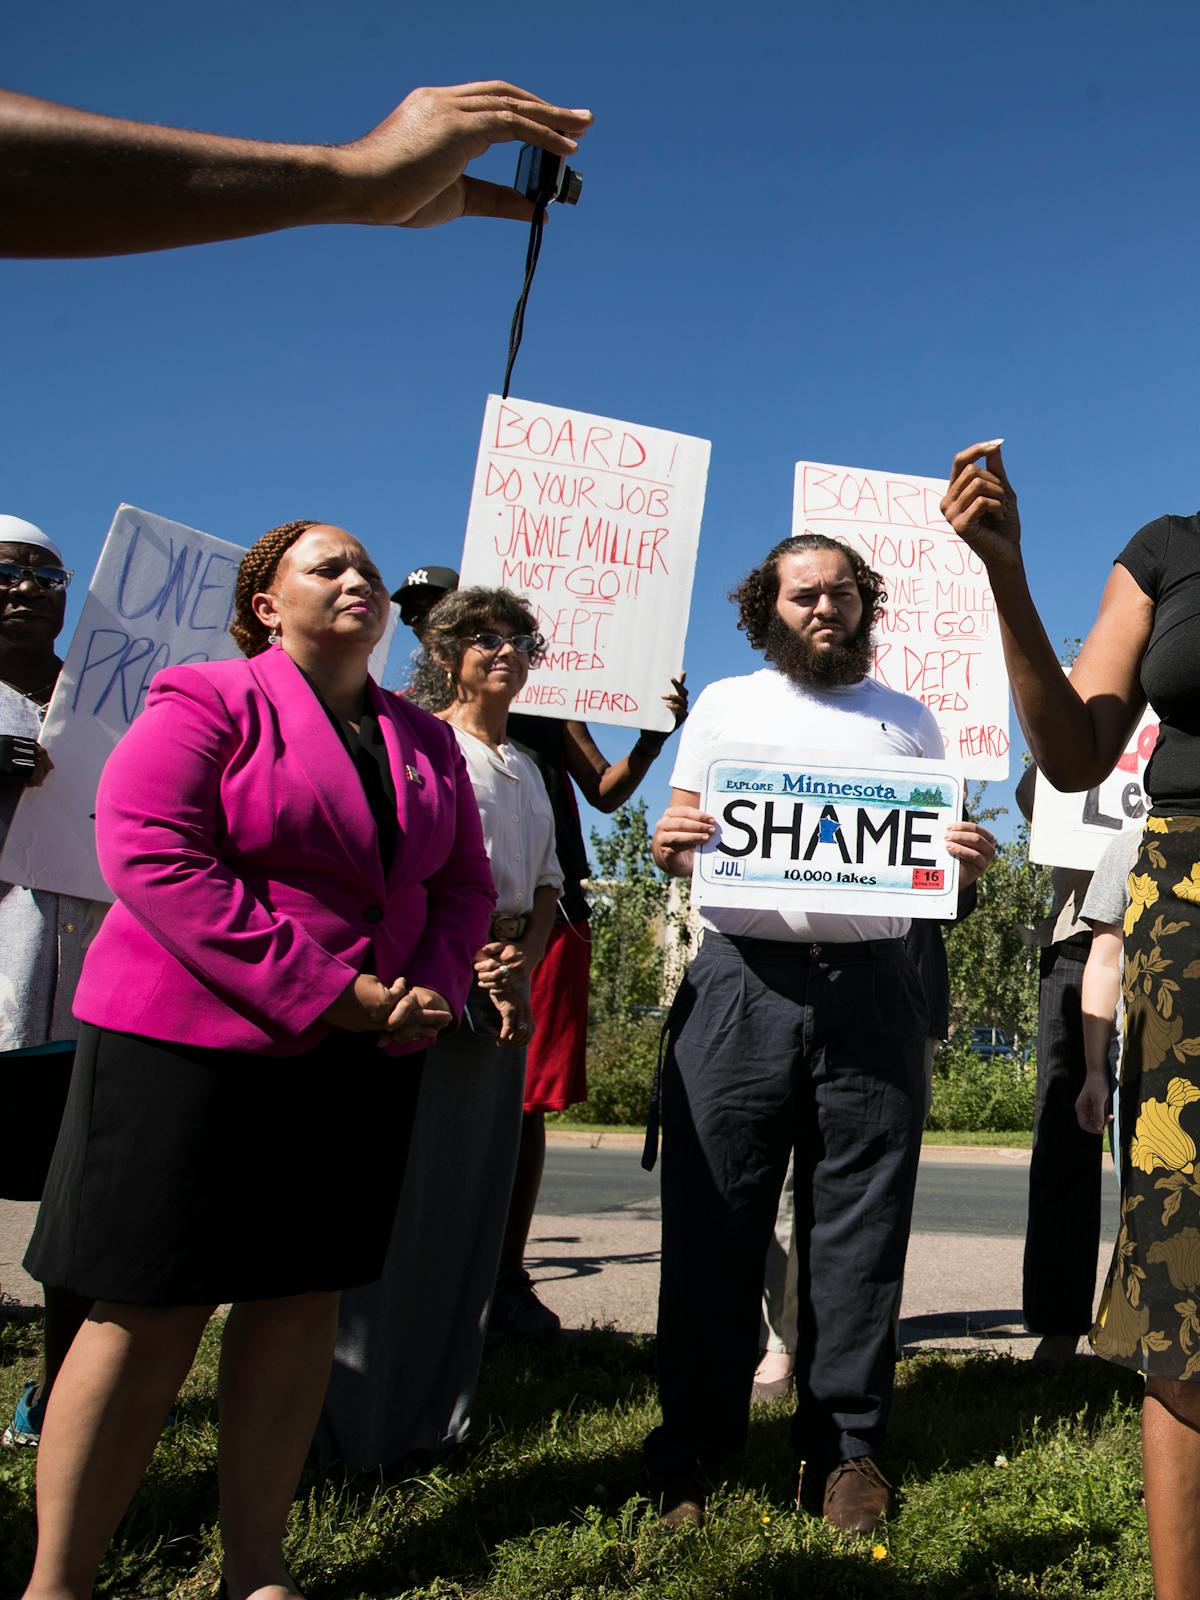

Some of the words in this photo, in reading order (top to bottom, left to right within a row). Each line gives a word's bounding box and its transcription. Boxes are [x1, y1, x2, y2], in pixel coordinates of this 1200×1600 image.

[495, 404, 647, 469] BOARD
[485, 462, 523, 502] DO
[532, 471, 598, 509] YOUR
[604, 483, 670, 518] JOB
[494, 504, 574, 560] JAYNE
[576, 515, 670, 576] MILLER
[858, 533, 937, 573] YOUR
[502, 559, 566, 592] MUST
[935, 578, 996, 614] MILLE
[903, 645, 982, 691] DEPT.
[573, 689, 639, 714] HEARD
[958, 725, 1010, 759] HEARD
[726, 780, 775, 792] EXPLORE
[781, 773, 898, 800] Minnesota
[714, 798, 940, 868] SHAME
[714, 860, 743, 879] JUL
[836, 870, 878, 886] lakes
[924, 870, 940, 883] 16
